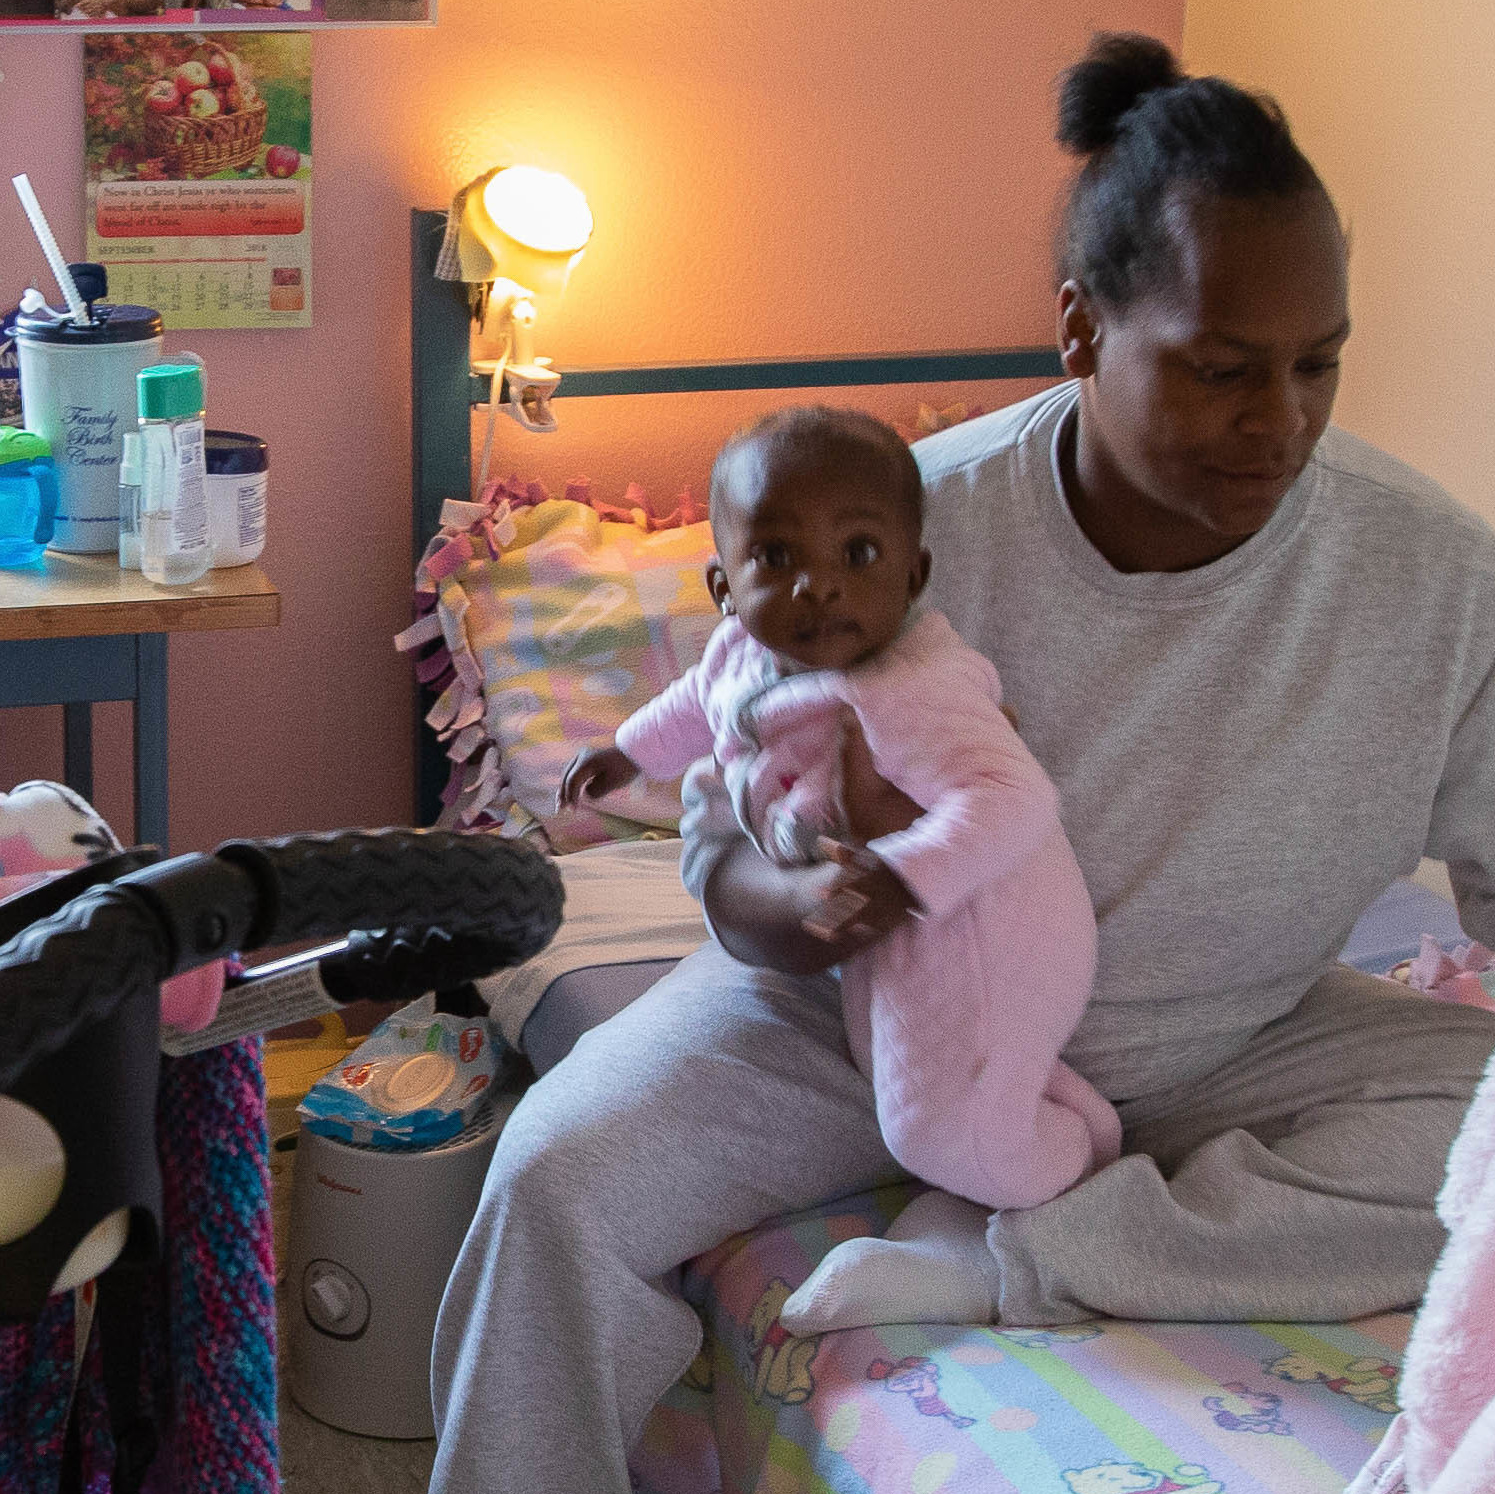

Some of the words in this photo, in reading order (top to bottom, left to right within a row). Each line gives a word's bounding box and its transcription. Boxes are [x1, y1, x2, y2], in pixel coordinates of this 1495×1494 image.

[99, 245, 154, 255] SEPTEMBER
[62, 405, 117, 430] Family
[67, 426, 113, 447] Birth
[67, 446, 118, 467] Center
